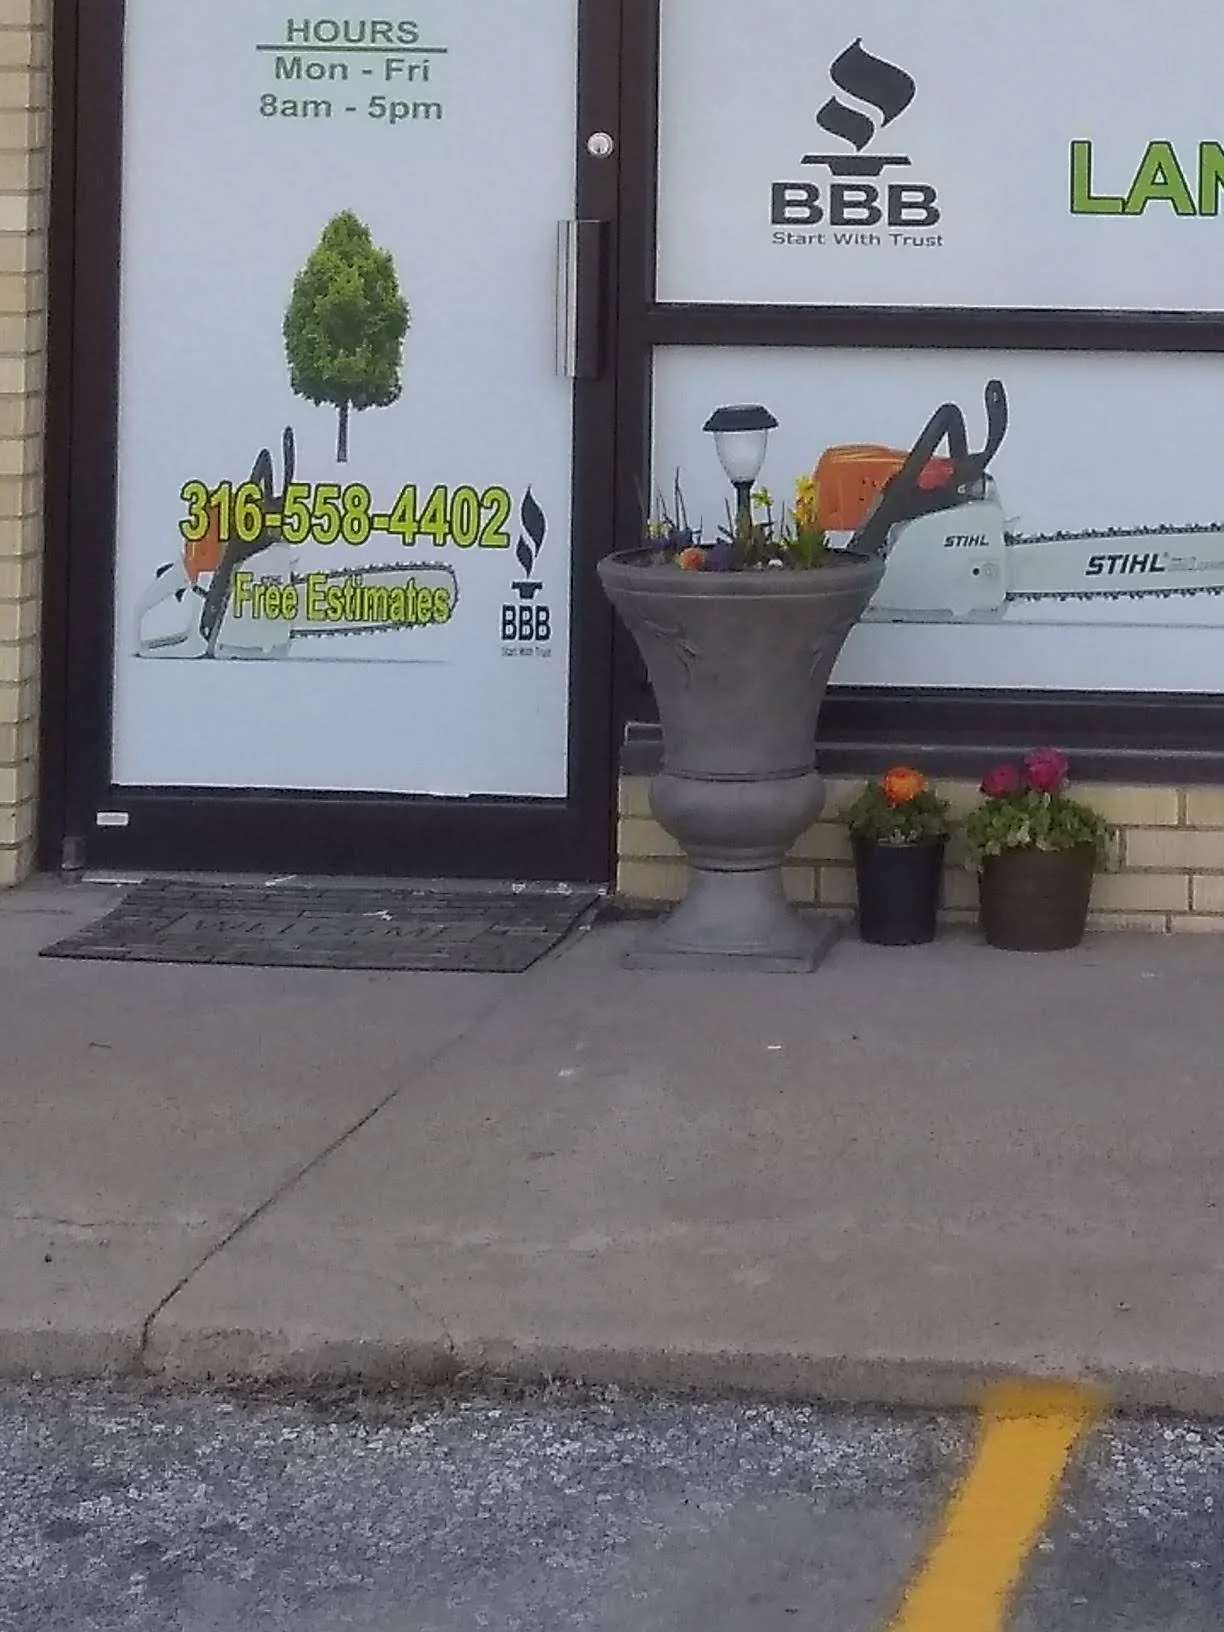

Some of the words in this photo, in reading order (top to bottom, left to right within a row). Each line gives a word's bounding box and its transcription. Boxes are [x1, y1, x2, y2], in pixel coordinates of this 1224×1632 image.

[286, 18, 420, 45] HOURS
[274, 55, 349, 81] Mon
[384, 58, 430, 82] Fri
[259, 93, 333, 118] 8am
[367, 96, 443, 125] 5pm
[771, 182, 941, 227] BBB
[772, 231, 826, 246] Start
[833, 233, 881, 246] With
[888, 233, 943, 247] Trust
[178, 480, 512, 548] 316-558-4402
[944, 534, 990, 548] STIHL
[1085, 553, 1165, 576] STIHL
[232, 570, 299, 620] Free
[305, 574, 452, 625] Estimates
[501, 604, 552, 642] BBB
